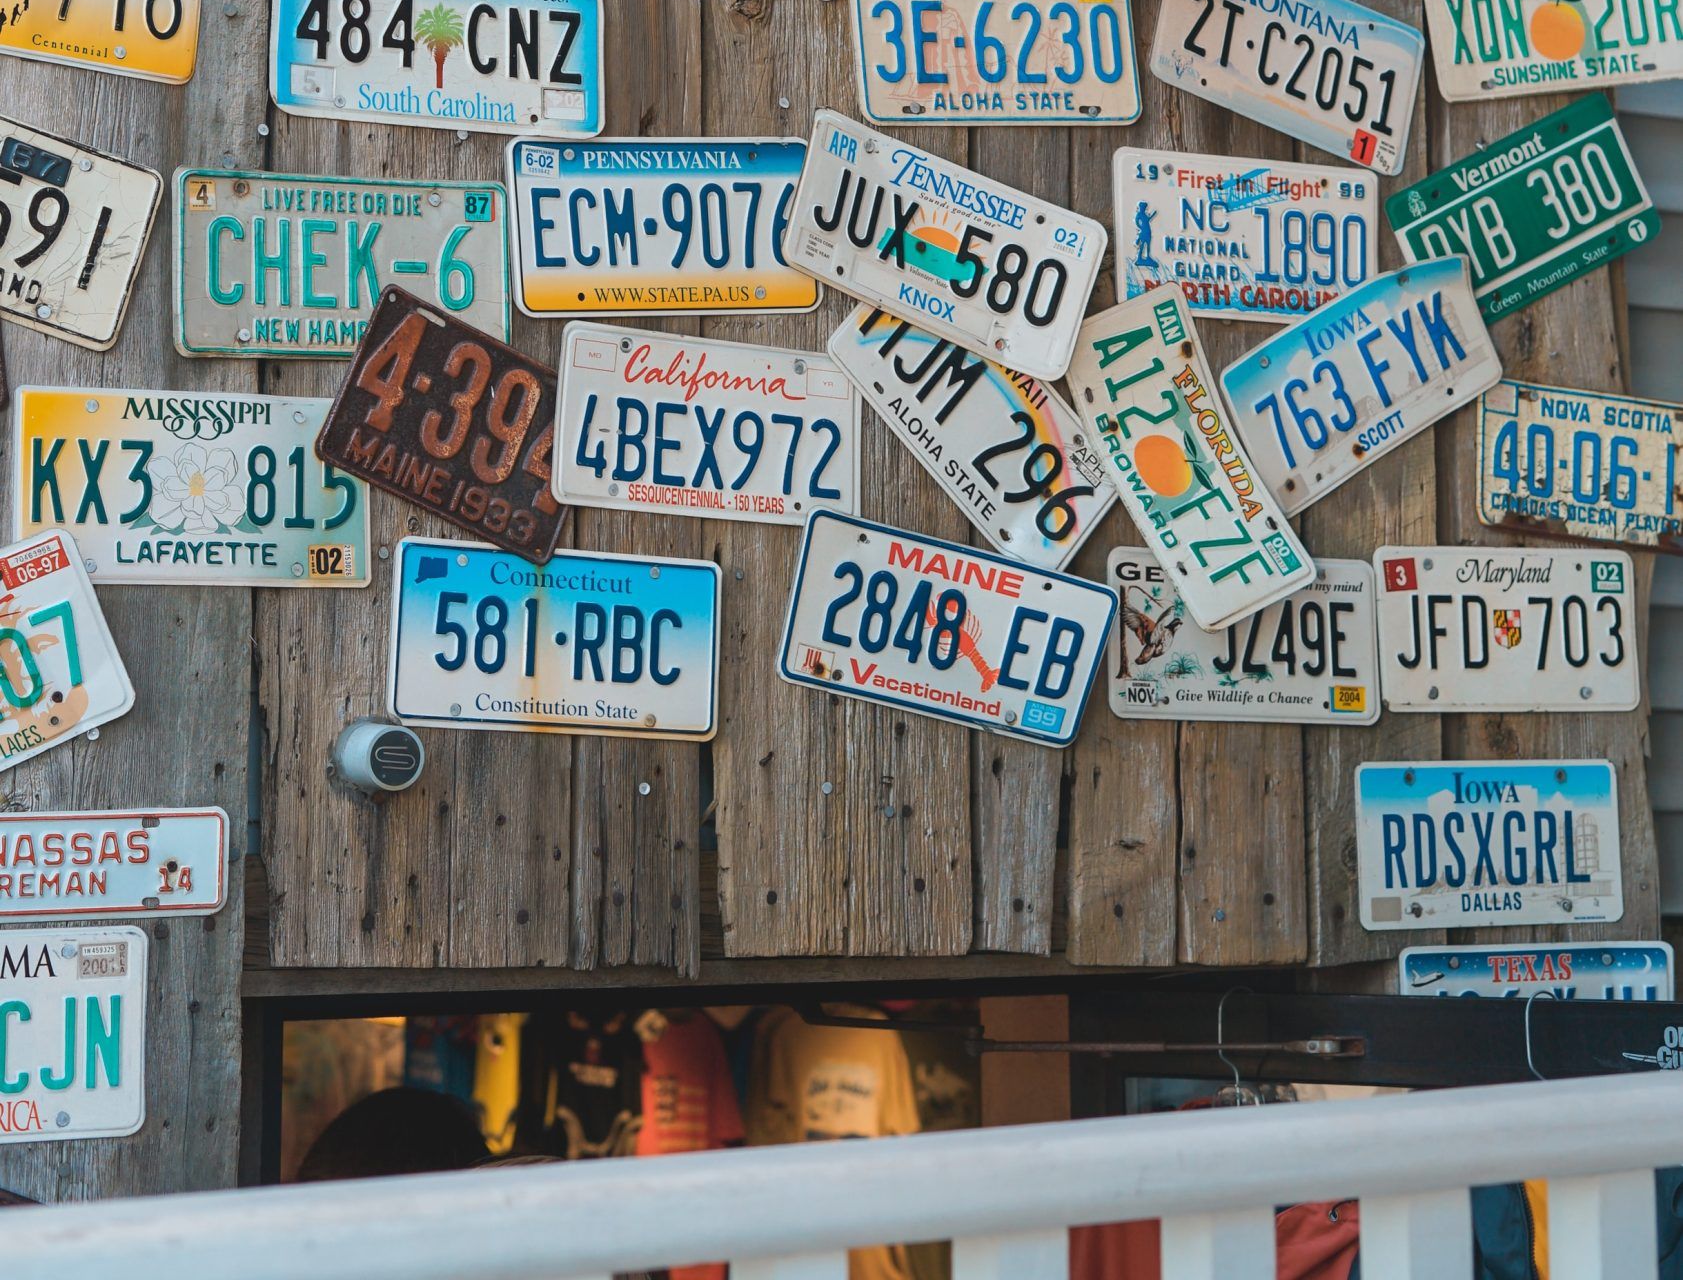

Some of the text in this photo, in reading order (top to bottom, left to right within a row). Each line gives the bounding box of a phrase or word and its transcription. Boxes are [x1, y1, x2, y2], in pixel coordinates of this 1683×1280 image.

[32, 33, 108, 58] Centennial
[466, 3, 583, 86] CNZ
[1493, 53, 1642, 87] SUNSHINE STATE
[358, 82, 517, 124] South Carolina
[933, 91, 1076, 113] ALOHA STATE
[525, 150, 742, 170] 6-02 PENNSYLVANIA
[828, 131, 1028, 231] APR TENNESSEE
[1450, 132, 1547, 193] Vermont
[261, 186, 422, 218] LIVE FREE DIE
[1177, 169, 1321, 202] First Flight
[1526, 142, 1623, 240] 380
[207, 215, 475, 312] CHEK-6
[813, 168, 1068, 327] JUX 580
[1163, 235, 1250, 260] NATIONAL
[1252, 207, 1367, 288] 1890
[1173, 260, 1241, 282] GUARD
[1489, 244, 1610, 314] Green Mountain State
[593, 286, 750, 303] WWW.STATE.PA.US
[899, 283, 956, 323] KNOX
[254, 319, 300, 344] NEW
[1155, 304, 1181, 344] JAN
[623, 344, 806, 402] California
[1254, 290, 1468, 470] 763 FYK
[121, 396, 272, 441] MISSISSIPPI
[1357, 409, 1406, 453] SCOTT
[1540, 397, 1673, 434] NOVA SCOTIA
[575, 393, 842, 500] 4BEX972
[888, 397, 997, 522] ALOHA STATE
[1172, 363, 1265, 523] FLORIDA
[31, 437, 357, 530] KX3 815
[342, 427, 451, 506] MAINE
[971, 409, 1095, 542] 296
[1095, 412, 1180, 550] BROWARD
[627, 483, 785, 515] SESQUICENTENNIAL 150 YEARS
[15, 552, 62, 582] 06-97
[115, 540, 279, 567] LAFAYETTE
[887, 541, 1025, 599] MAINE
[490, 561, 633, 595] Connecticut
[1332, 581, 1364, 594] mind
[1456, 558, 1554, 592] Maryland
[821, 561, 1085, 700] 2848 EB
[1398, 594, 1625, 670] JFD 703
[474, 693, 639, 720] Constitution State
[849, 657, 1002, 718] Vacationland
[1175, 688, 1313, 705] Give Wildlife Chance
[1381, 810, 1592, 890] RDSXGRL
[159, 867, 193, 894] 14
[1461, 891, 1523, 913] DALLAS
[1487, 953, 1574, 984] TEXAS
